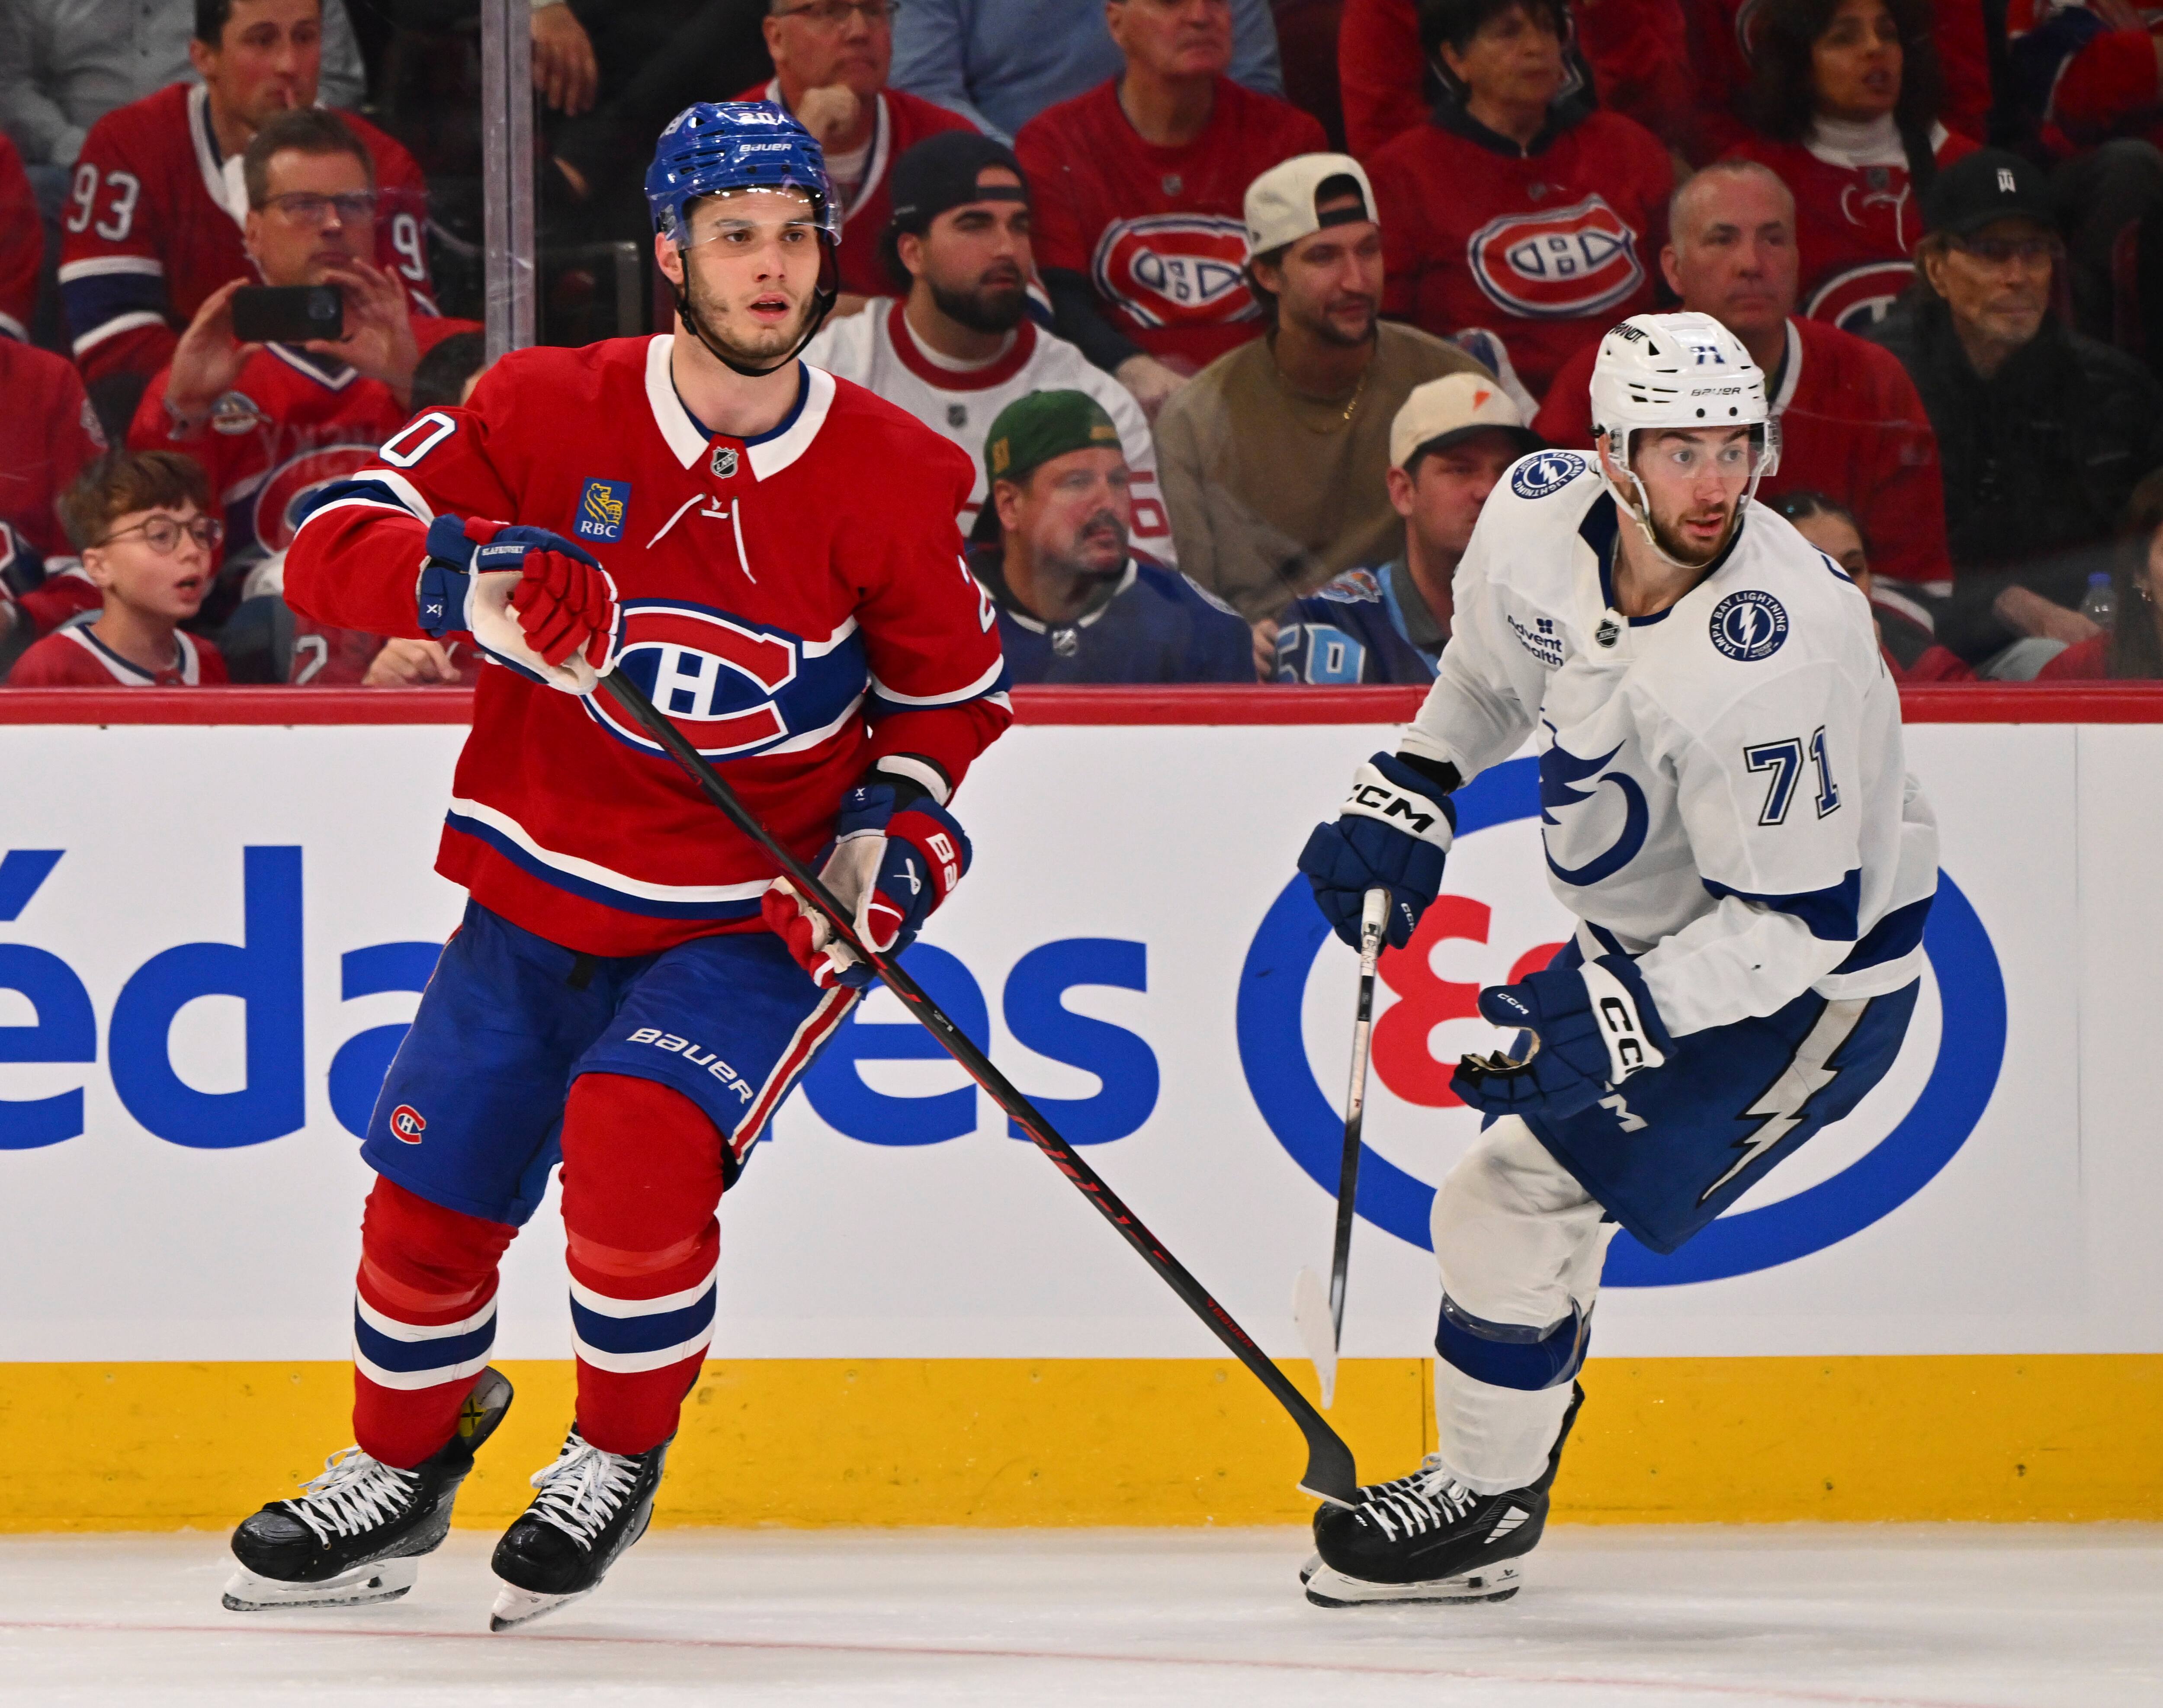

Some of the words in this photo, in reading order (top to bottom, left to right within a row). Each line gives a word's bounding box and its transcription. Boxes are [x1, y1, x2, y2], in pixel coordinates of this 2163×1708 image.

[67, 163, 140, 241] 93
[1689, 346, 1726, 364] 71
[581, 520, 618, 537] RBC
[1714, 599, 1732, 619] BAY
[1735, 592, 1786, 631] LIGHTNING
[1508, 615, 1563, 653] Advent
[1712, 623, 1736, 657] TAMPA
[1743, 725, 1841, 827] 71
[1497, 993, 1529, 1015] CCM
